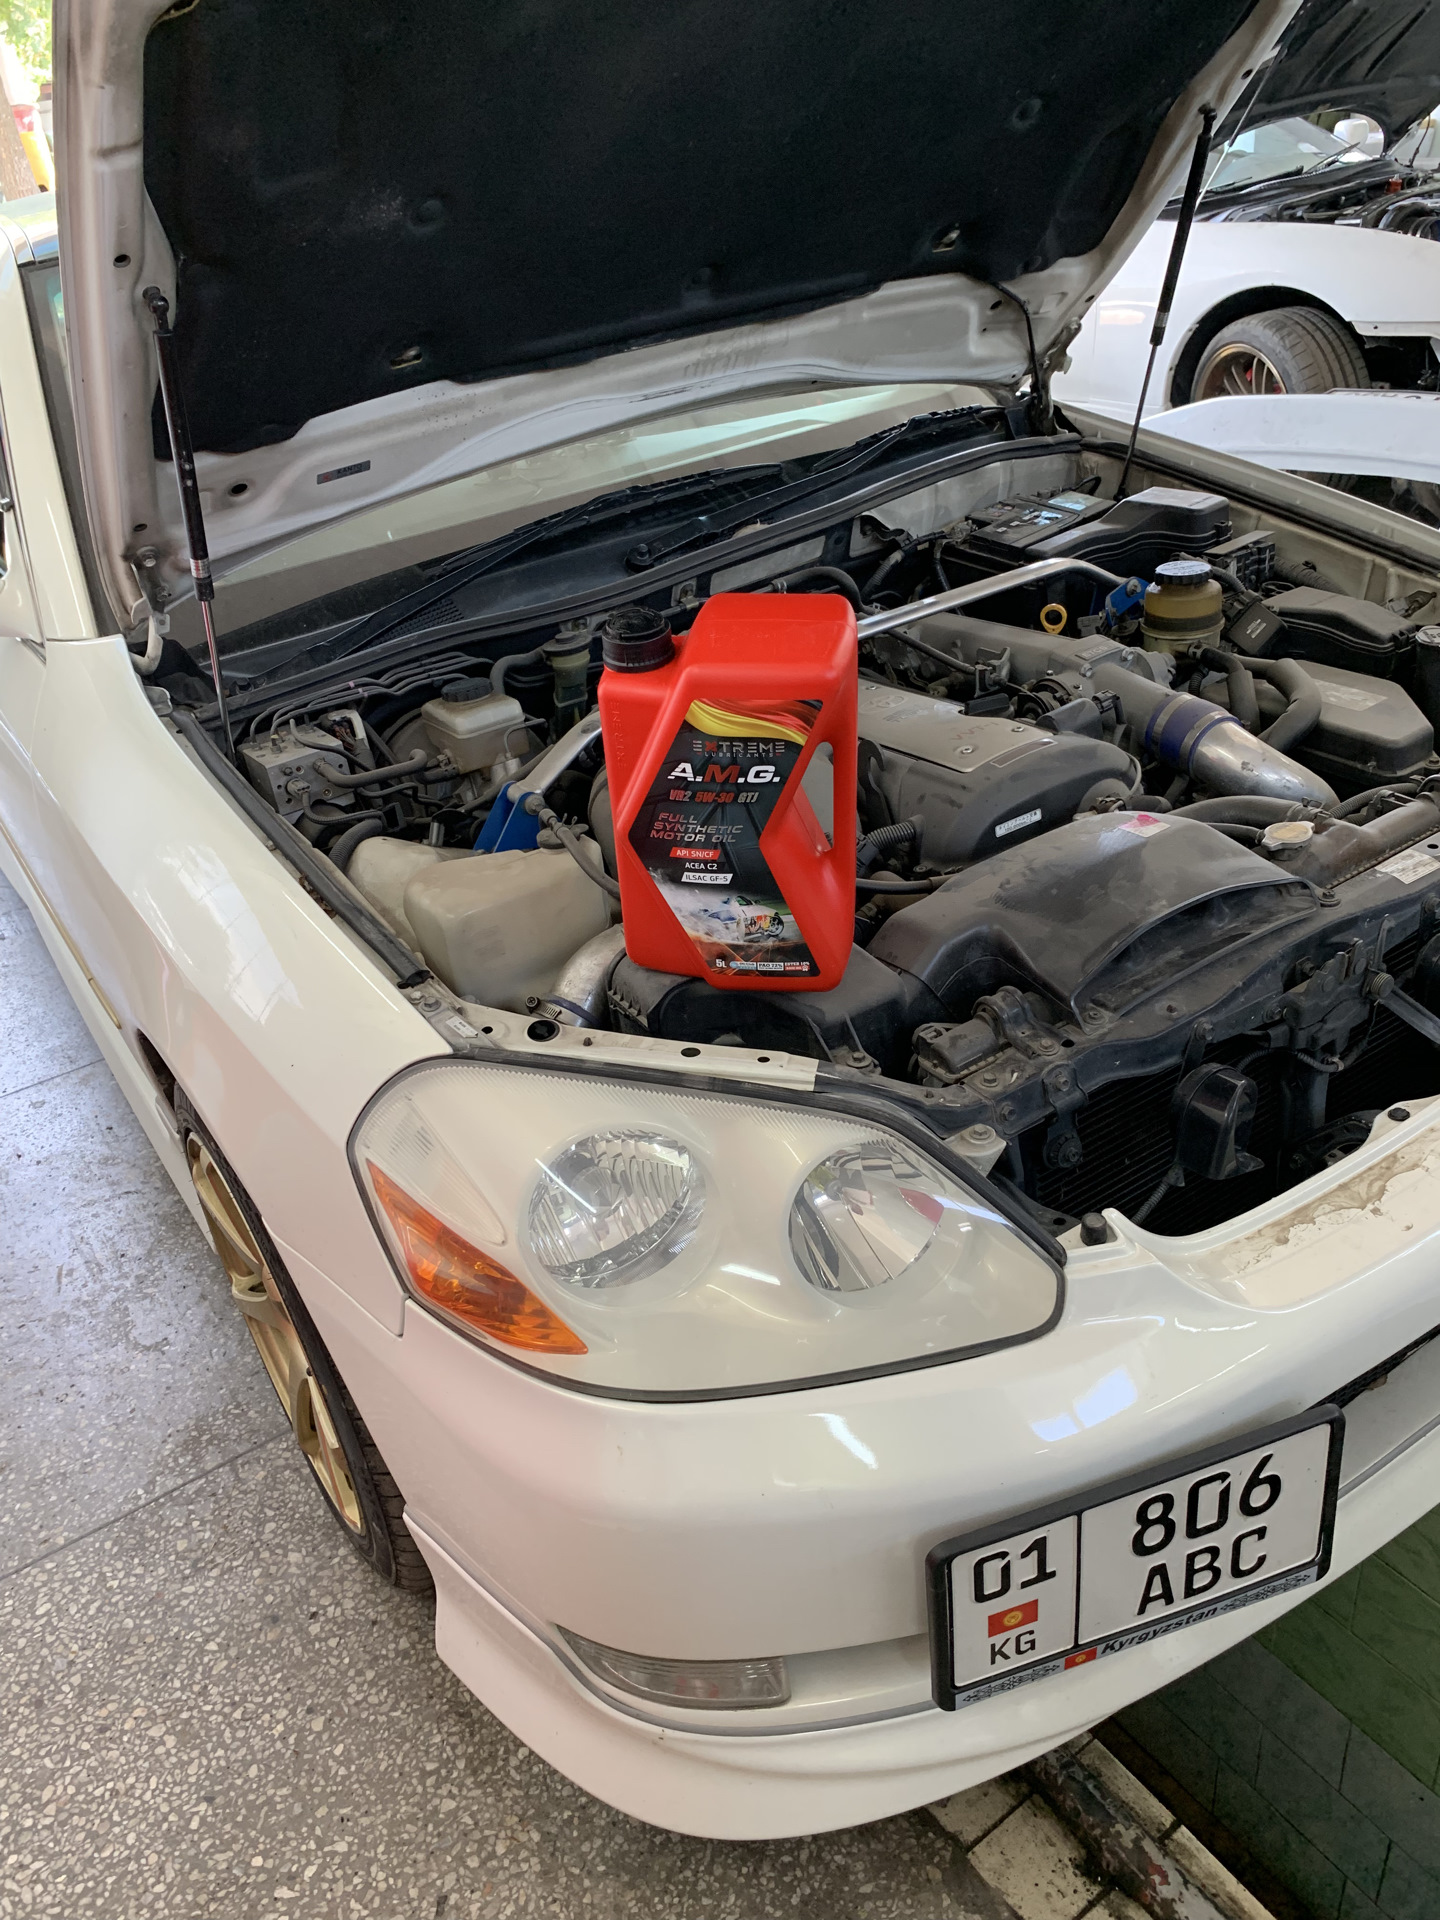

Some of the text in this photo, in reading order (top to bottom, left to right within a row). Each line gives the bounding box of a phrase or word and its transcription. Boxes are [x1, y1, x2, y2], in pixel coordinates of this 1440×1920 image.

[693, 740, 785, 753] EXTREME
[667, 762, 781, 784] A.M.G.
[669, 789, 692, 802] VR2
[695, 791, 735, 803] 5W-30
[658, 812, 698, 824] FULL
[653, 821, 744, 834] SYNTHETIC
[649, 830, 737, 843] MOTOR OIL
[676, 849, 715, 858] API SN/CF
[685, 862, 706, 870] ACEA
[685, 873, 708, 881] ILSAC
[715, 958, 727, 968] 5L
[1131, 1453, 1282, 1557] 806
[973, 1535, 1057, 1603] 01
[1136, 1525, 1268, 1617] ABC
[1101, 1605, 1218, 1656] Kyrgyzstan
[989, 1629, 1036, 1666] KG
